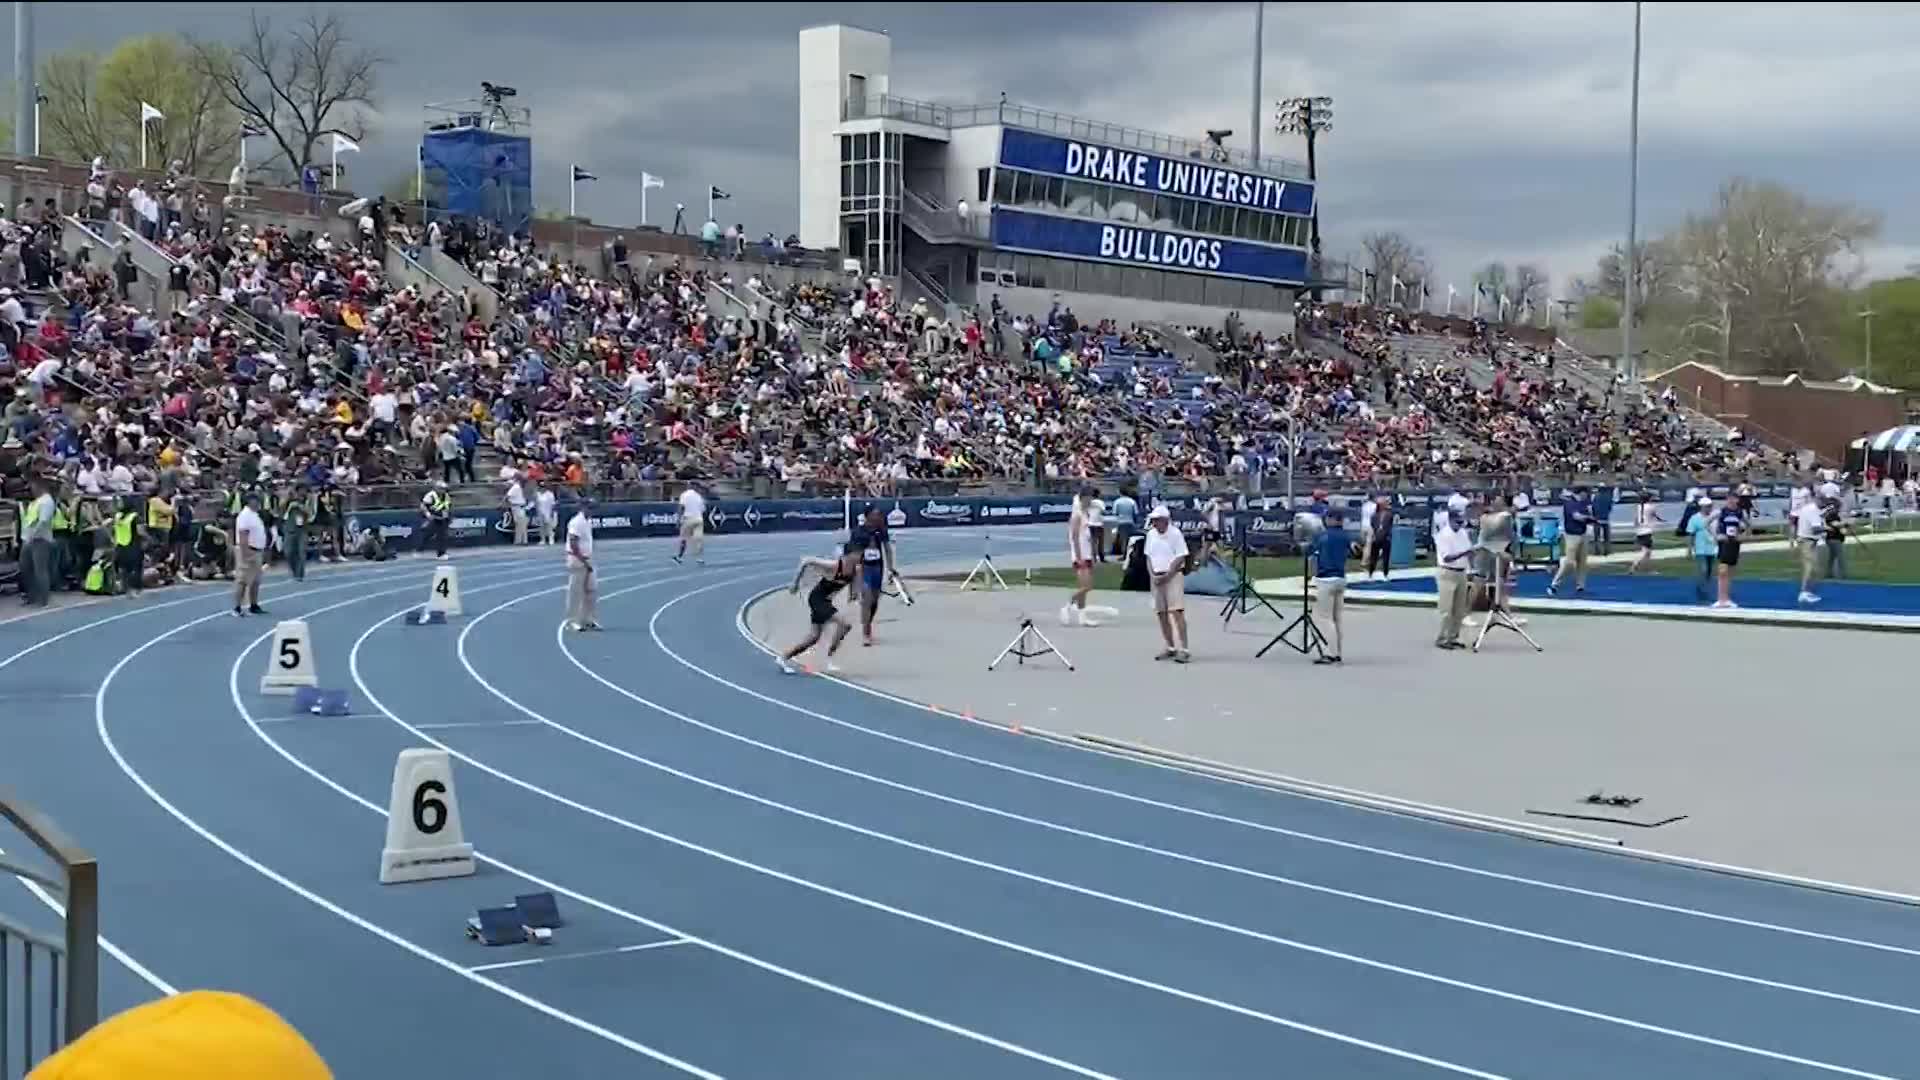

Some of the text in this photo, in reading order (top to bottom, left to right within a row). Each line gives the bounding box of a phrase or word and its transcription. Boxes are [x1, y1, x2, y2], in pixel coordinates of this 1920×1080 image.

[1066, 143, 1286, 209] DRAKE UNIVERSITY
[1100, 225, 1222, 270] BULLDOGS
[436, 577, 450, 598] 4
[279, 638, 300, 670] 5
[412, 779, 448, 835] 6
